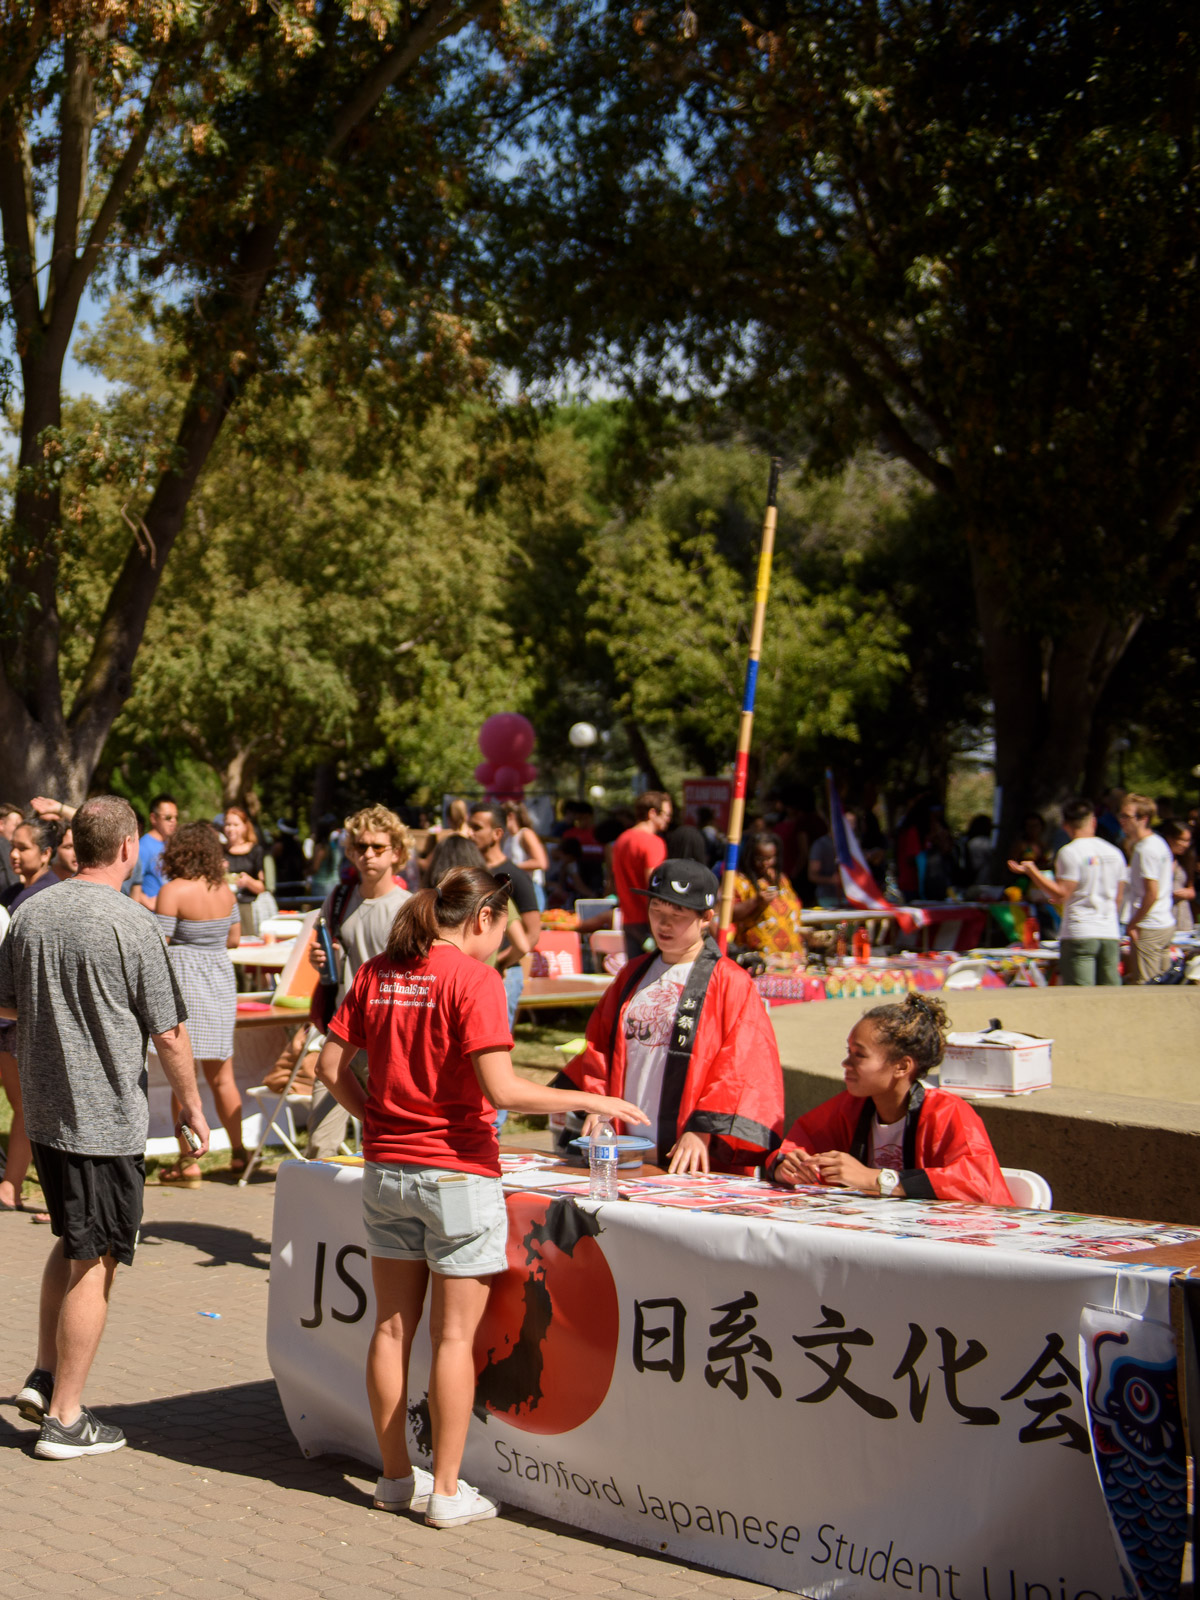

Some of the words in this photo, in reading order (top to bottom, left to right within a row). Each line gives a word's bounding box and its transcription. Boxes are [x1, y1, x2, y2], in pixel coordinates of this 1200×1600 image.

[678, 998, 696, 1047] お祭り
[632, 1290, 1092, 1455] 日系文化会
[494, 1439, 625, 1508] Stanford
[637, 1484, 801, 1555] Japanese
[810, 1523, 961, 1600] Student
[983, 1566, 1136, 1600] Uni
